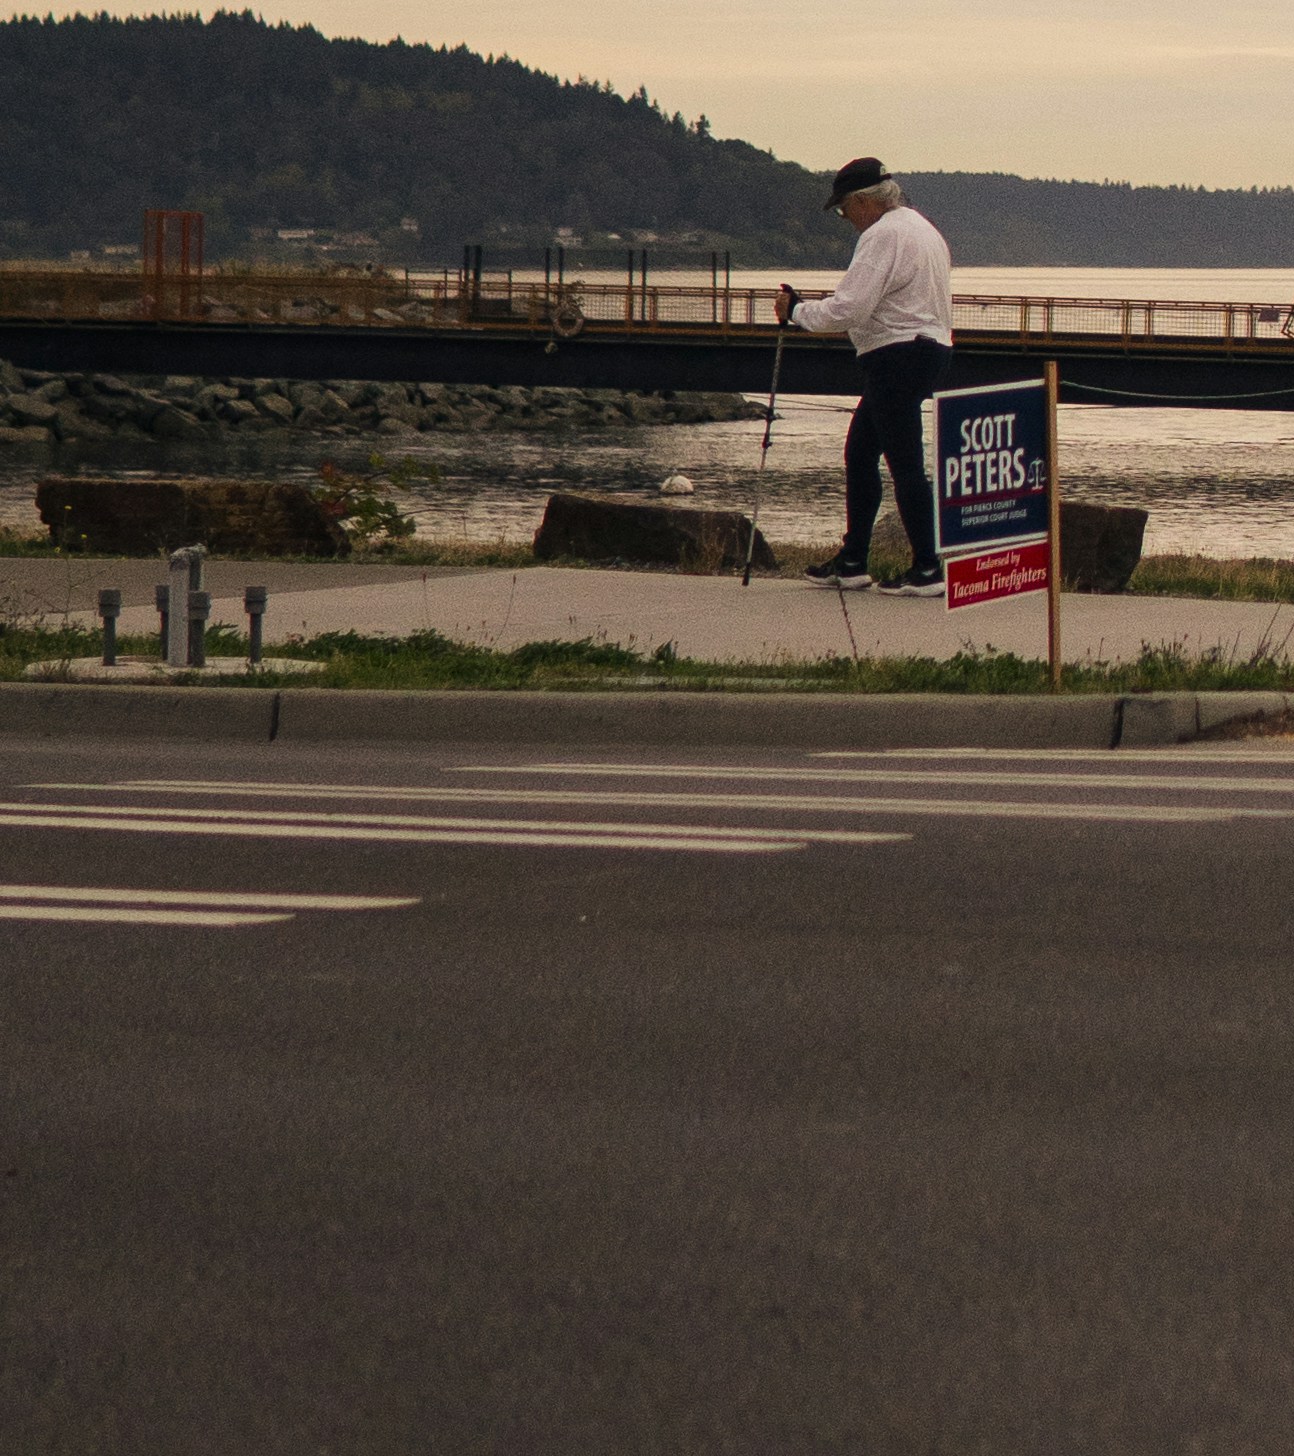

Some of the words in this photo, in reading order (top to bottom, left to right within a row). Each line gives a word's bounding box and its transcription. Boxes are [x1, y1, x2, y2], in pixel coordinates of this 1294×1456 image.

[960, 413, 1016, 454] SCOTT
[945, 447, 1026, 499] PETERS
[961, 504, 973, 515] FOR
[993, 499, 1016, 509] COUNTY
[961, 514, 989, 527] SUPERIOR
[989, 511, 1008, 522] COURT
[1008, 509, 1028, 520] JUDGE
[975, 550, 1010, 572] Endorsed
[1011, 551, 1021, 567] by
[952, 579, 990, 599] Tacoma
[991, 566, 1047, 592] Firefighters
